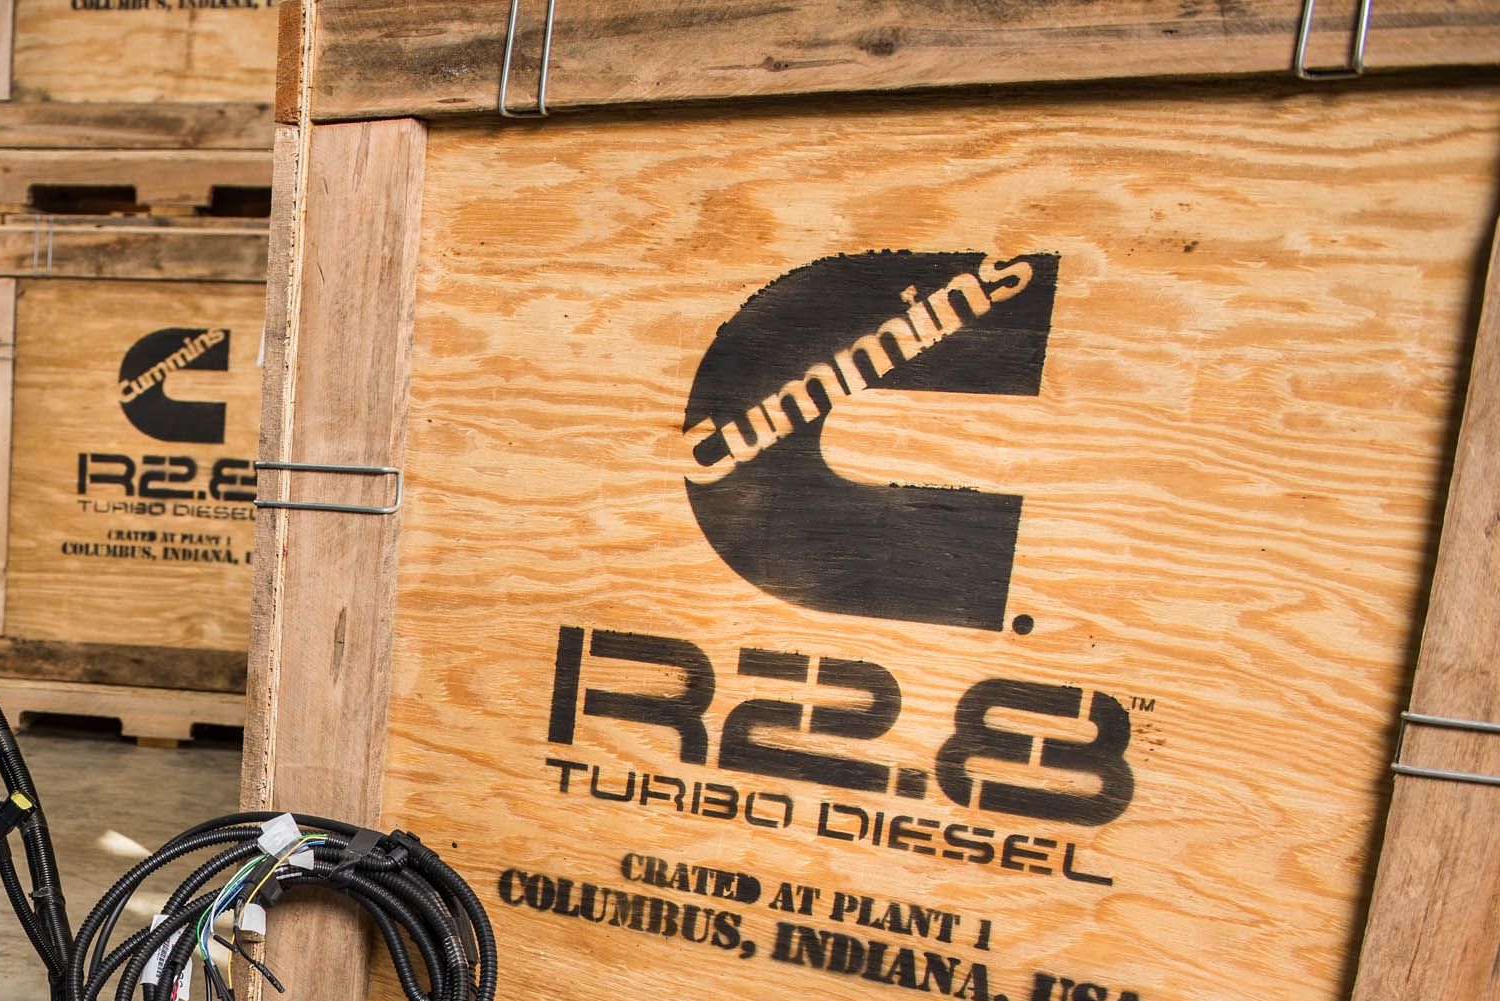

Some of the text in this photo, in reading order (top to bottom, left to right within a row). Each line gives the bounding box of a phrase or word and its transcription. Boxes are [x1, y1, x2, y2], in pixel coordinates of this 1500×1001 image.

[118, 328, 226, 404] Cummins
[684, 253, 1035, 484] Cummins
[77, 453, 258, 501] R2.8
[77, 499, 167, 515] TURBO
[61, 541, 157, 561] COLUMBUS,
[162, 546, 239, 565] INDIANA,
[107, 529, 158, 543] CRATED
[159, 531, 177, 543] AT
[180, 532, 221, 546] PLANT
[546, 625, 1137, 828] R2.8
[545, 756, 1115, 888] TURBO DIESEL
[497, 866, 759, 961] COLUMBUS,
[620, 851, 993, 952] CRATED AT PLANT 1
